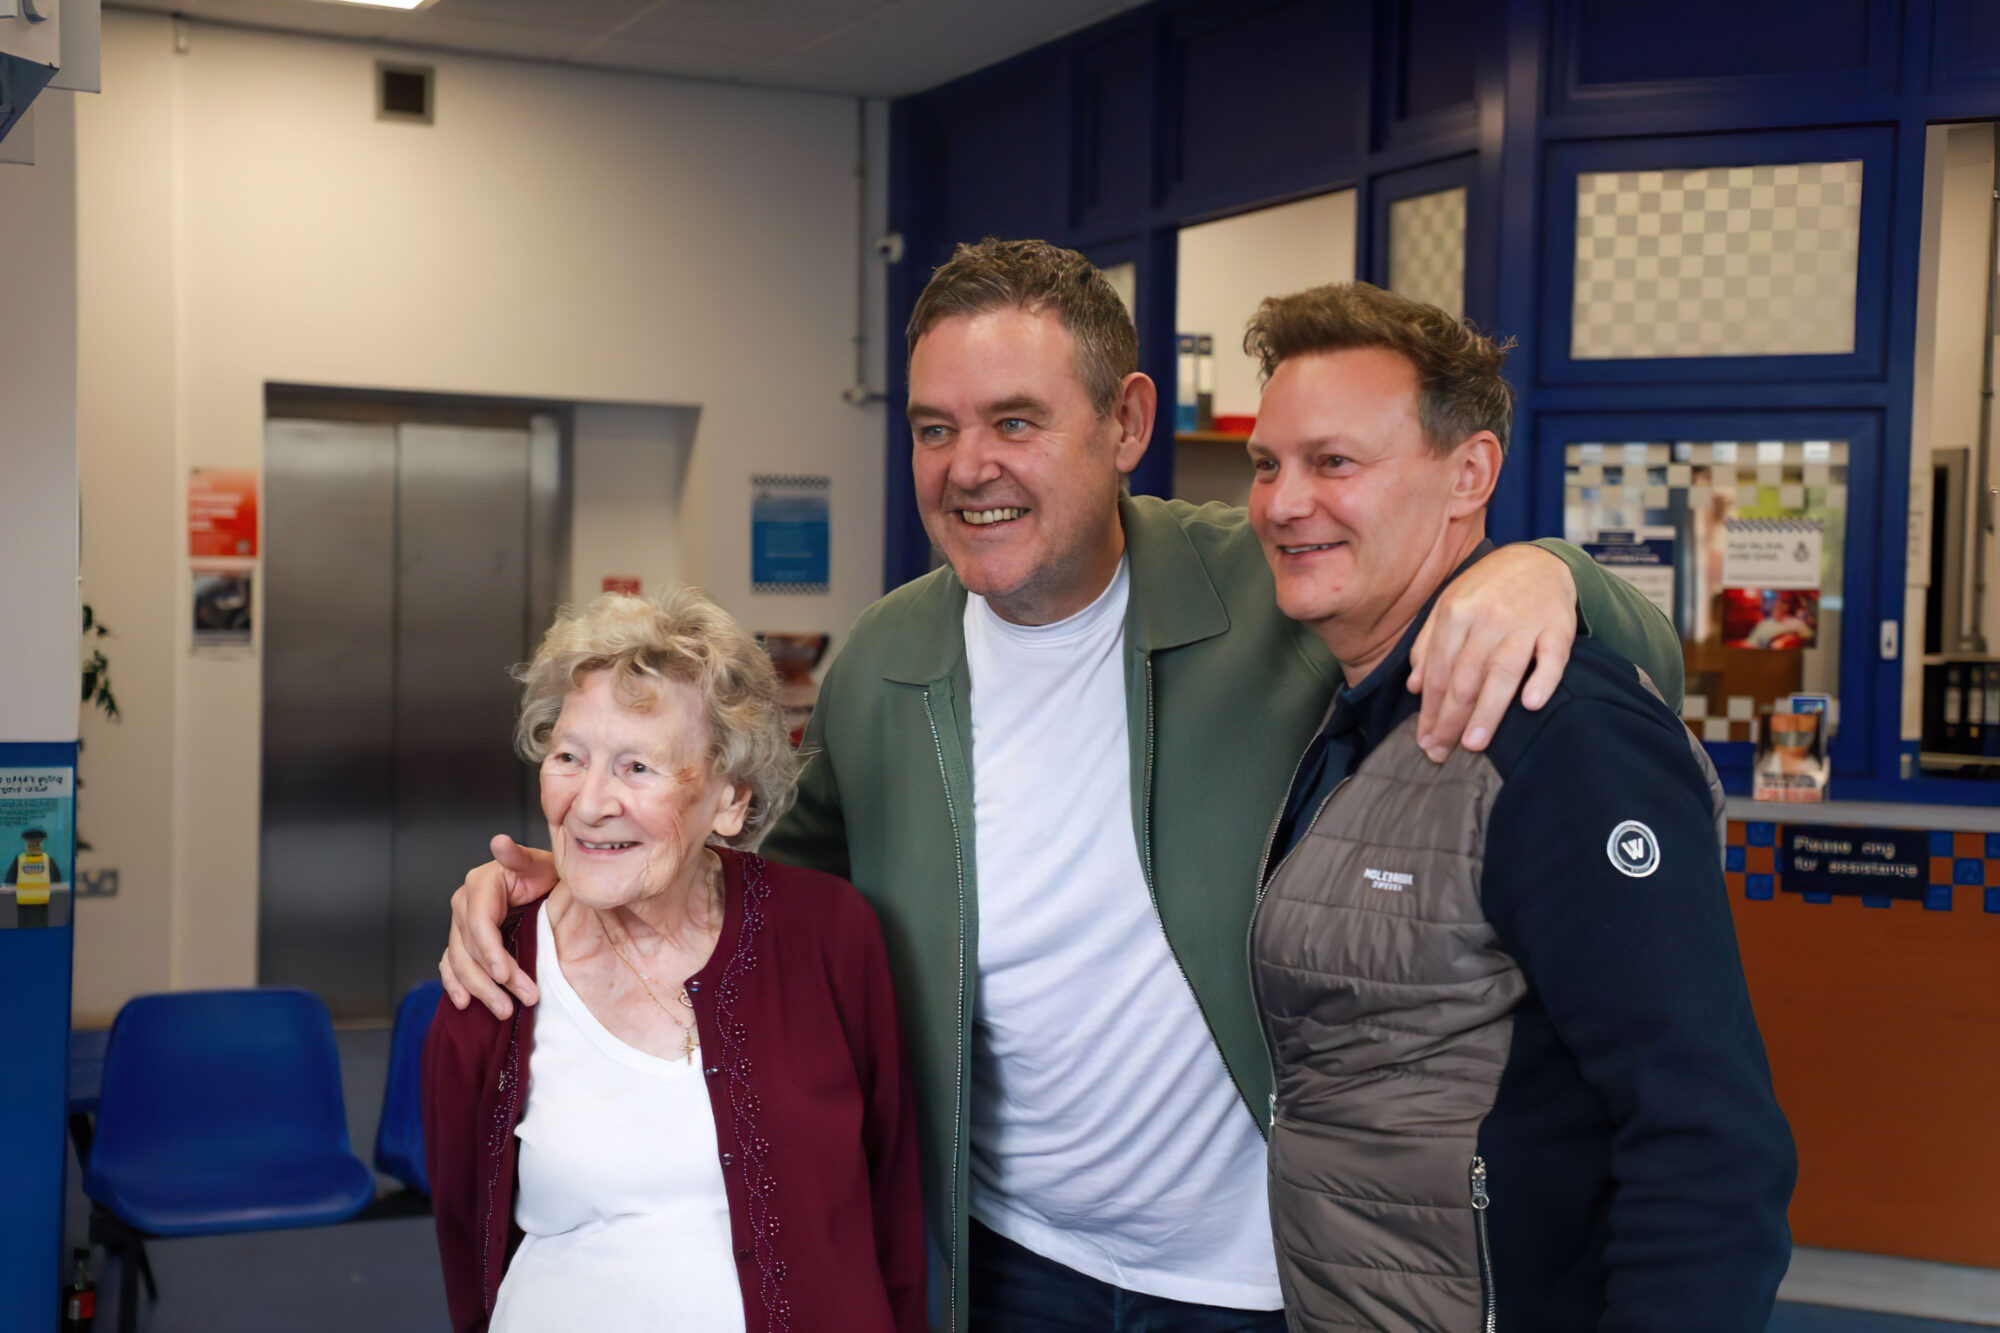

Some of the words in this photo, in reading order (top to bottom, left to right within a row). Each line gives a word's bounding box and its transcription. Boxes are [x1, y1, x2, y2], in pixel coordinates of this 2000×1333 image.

[1793, 835, 1852, 855] Please
[1794, 856, 1818, 872] for
[1828, 859, 1919, 878] assistance
